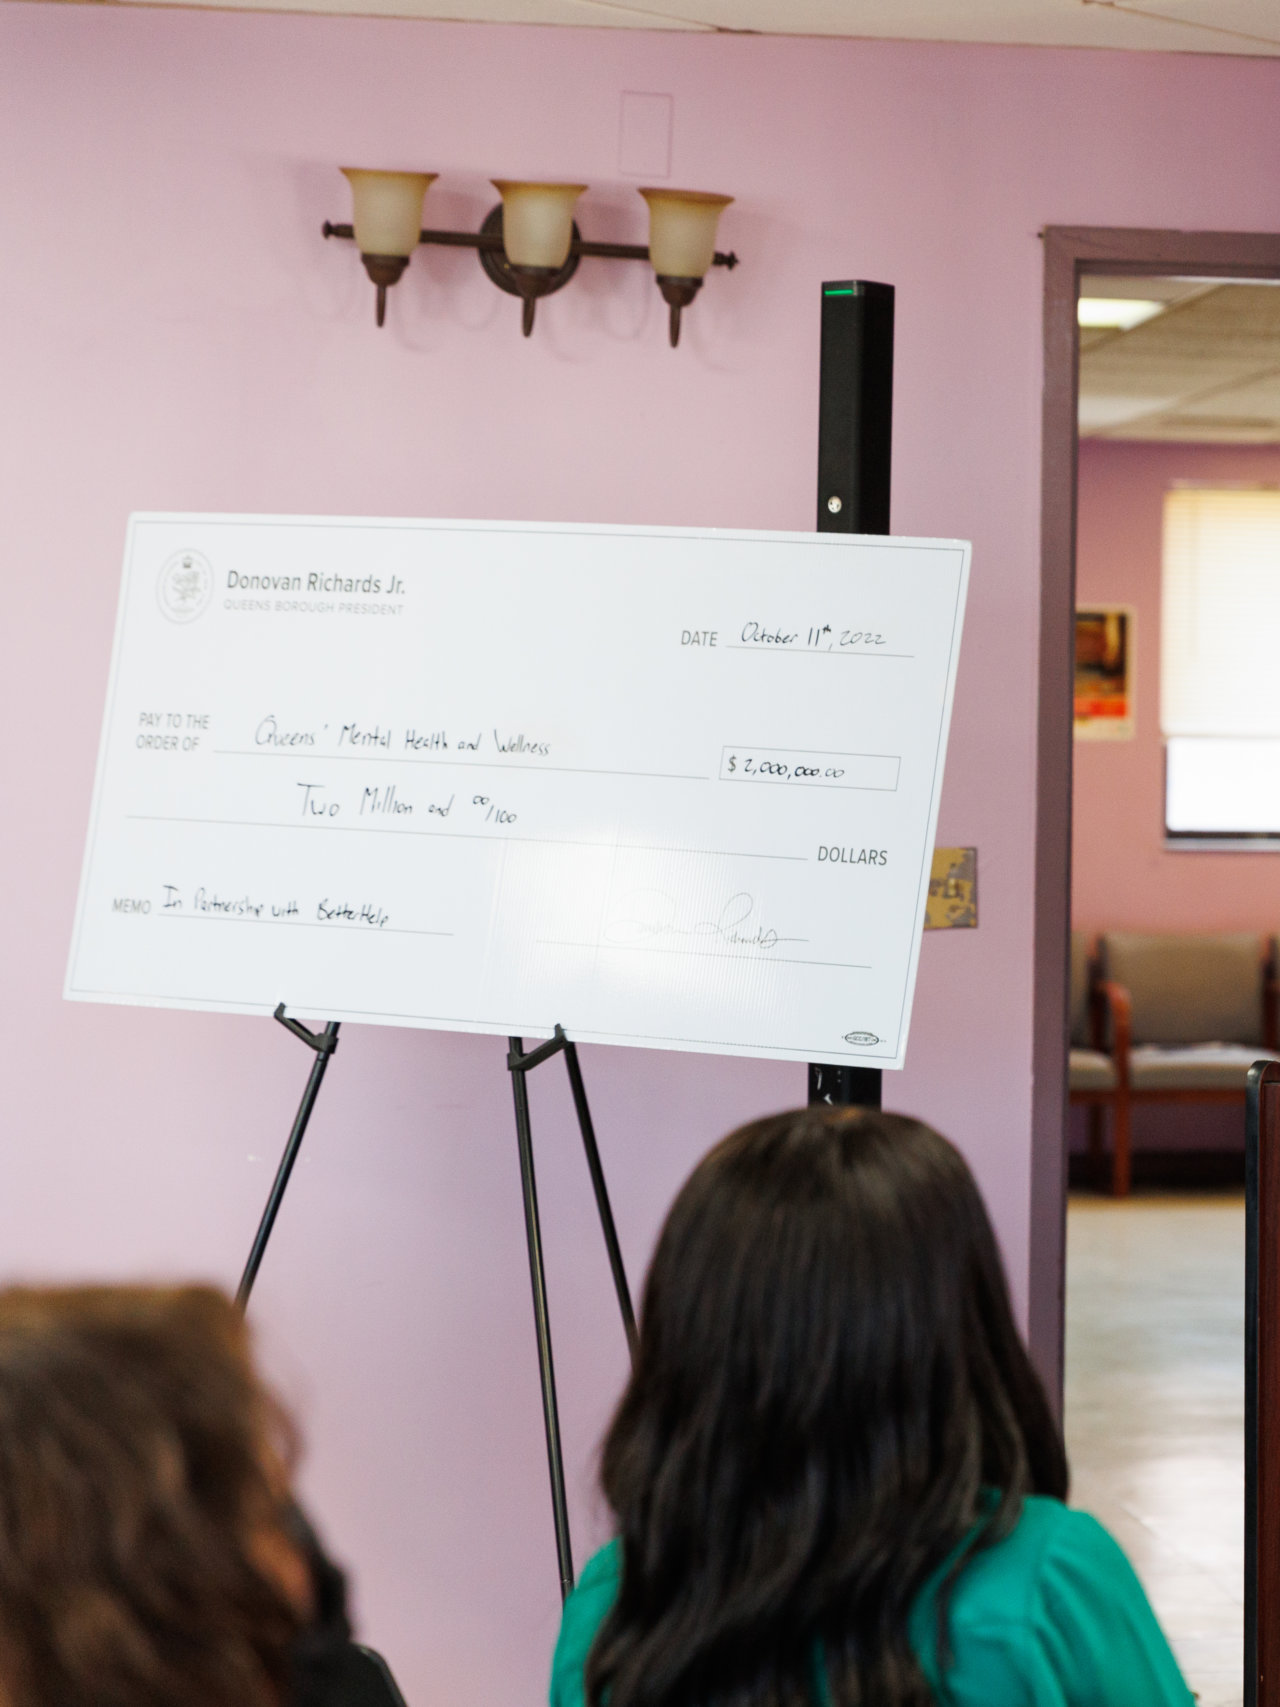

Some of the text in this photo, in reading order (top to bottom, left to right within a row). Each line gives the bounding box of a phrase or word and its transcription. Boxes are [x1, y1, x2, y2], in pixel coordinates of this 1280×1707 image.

[227, 570, 406, 595] Donovan Richards Jr.
[223, 599, 404, 616] QUEENS BOROUGH PRESIDENT
[681, 630, 718, 648] DATE
[740, 622, 798, 644] October
[839, 630, 887, 646] 2022
[139, 712, 210, 730] PAY TO THE
[136, 735, 200, 752] ORDER OF
[338, 723, 391, 750] Mental
[404, 729, 448, 750] Health
[457, 732, 482, 751] and
[494, 728, 551, 756] Wellness
[296, 783, 340, 817] Two
[360, 785, 413, 816] Million
[428, 794, 455, 817] and
[817, 845, 888, 866] DOLLARS
[111, 897, 151, 915] MEMO
[162, 884, 389, 928] In Partnership with BetterHelp
